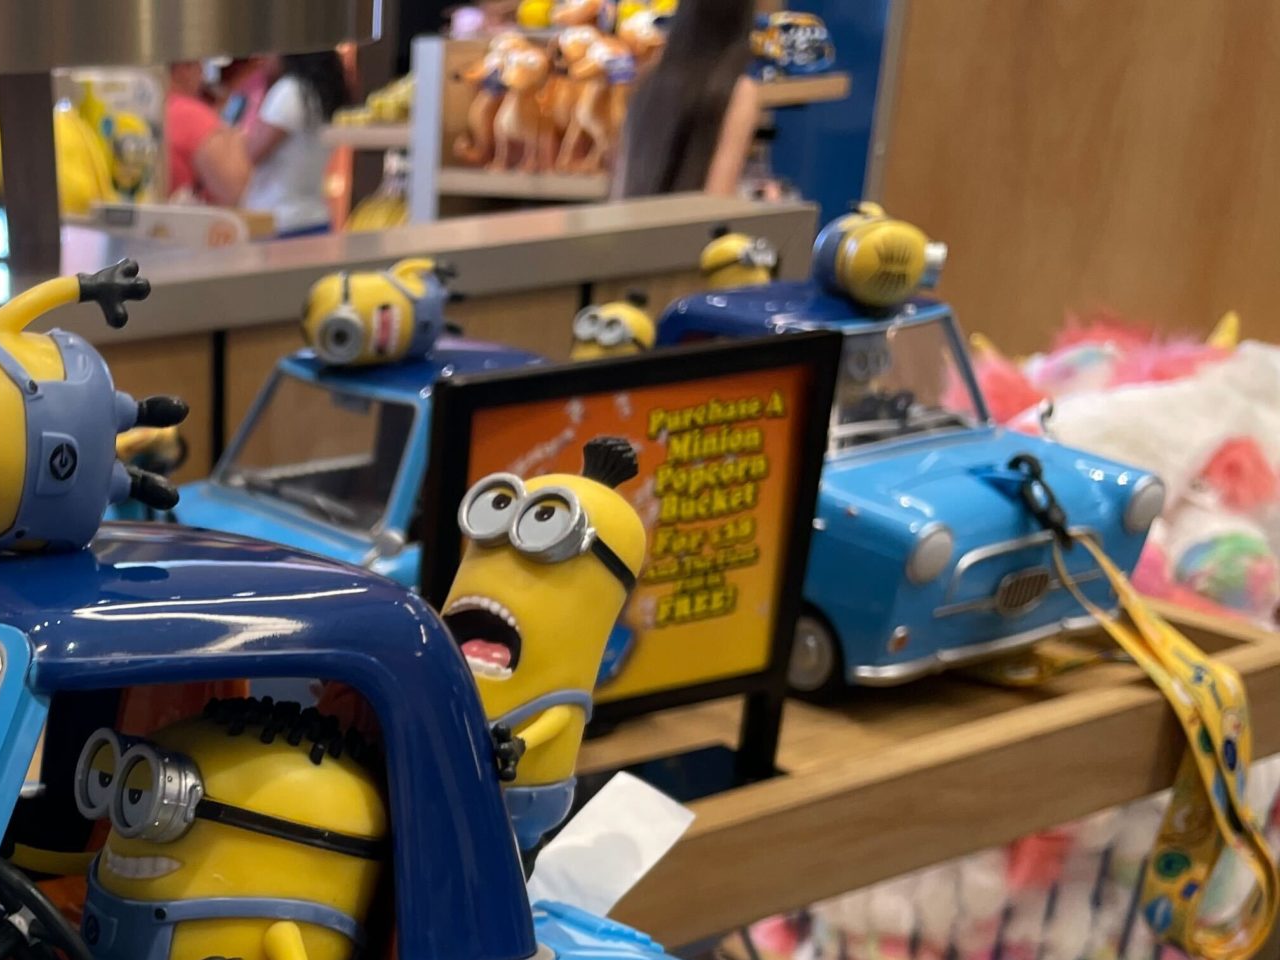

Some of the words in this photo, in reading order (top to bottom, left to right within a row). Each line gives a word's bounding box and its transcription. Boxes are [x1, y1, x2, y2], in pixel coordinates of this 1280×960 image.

[648, 397, 762, 439] Purchase
[766, 390, 785, 416] A
[668, 424, 762, 464] Minion
[655, 454, 768, 496] Popcorn
[660, 482, 756, 521] Bucket
[656, 585, 737, 627] FREE!
